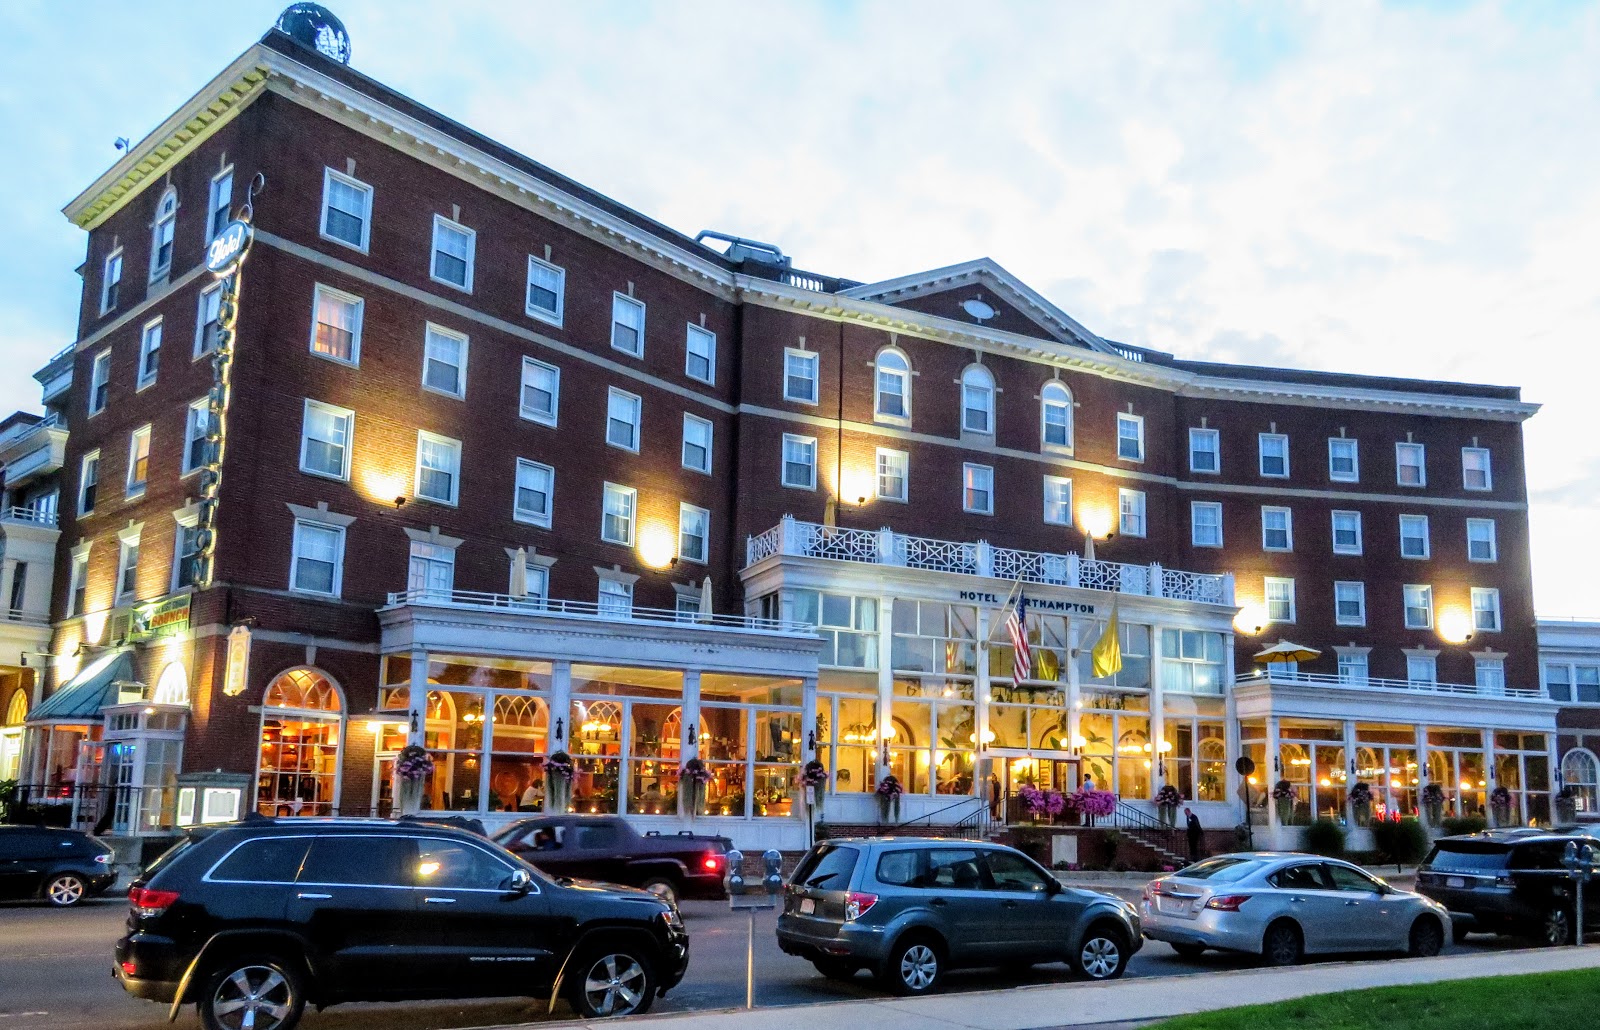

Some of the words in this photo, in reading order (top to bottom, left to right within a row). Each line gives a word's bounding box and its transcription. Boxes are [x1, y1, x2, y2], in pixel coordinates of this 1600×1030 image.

[208, 226, 243, 268] Hotel
[960, 590, 998, 603] HOTEL
[151, 606, 189, 627] BRUNCH
